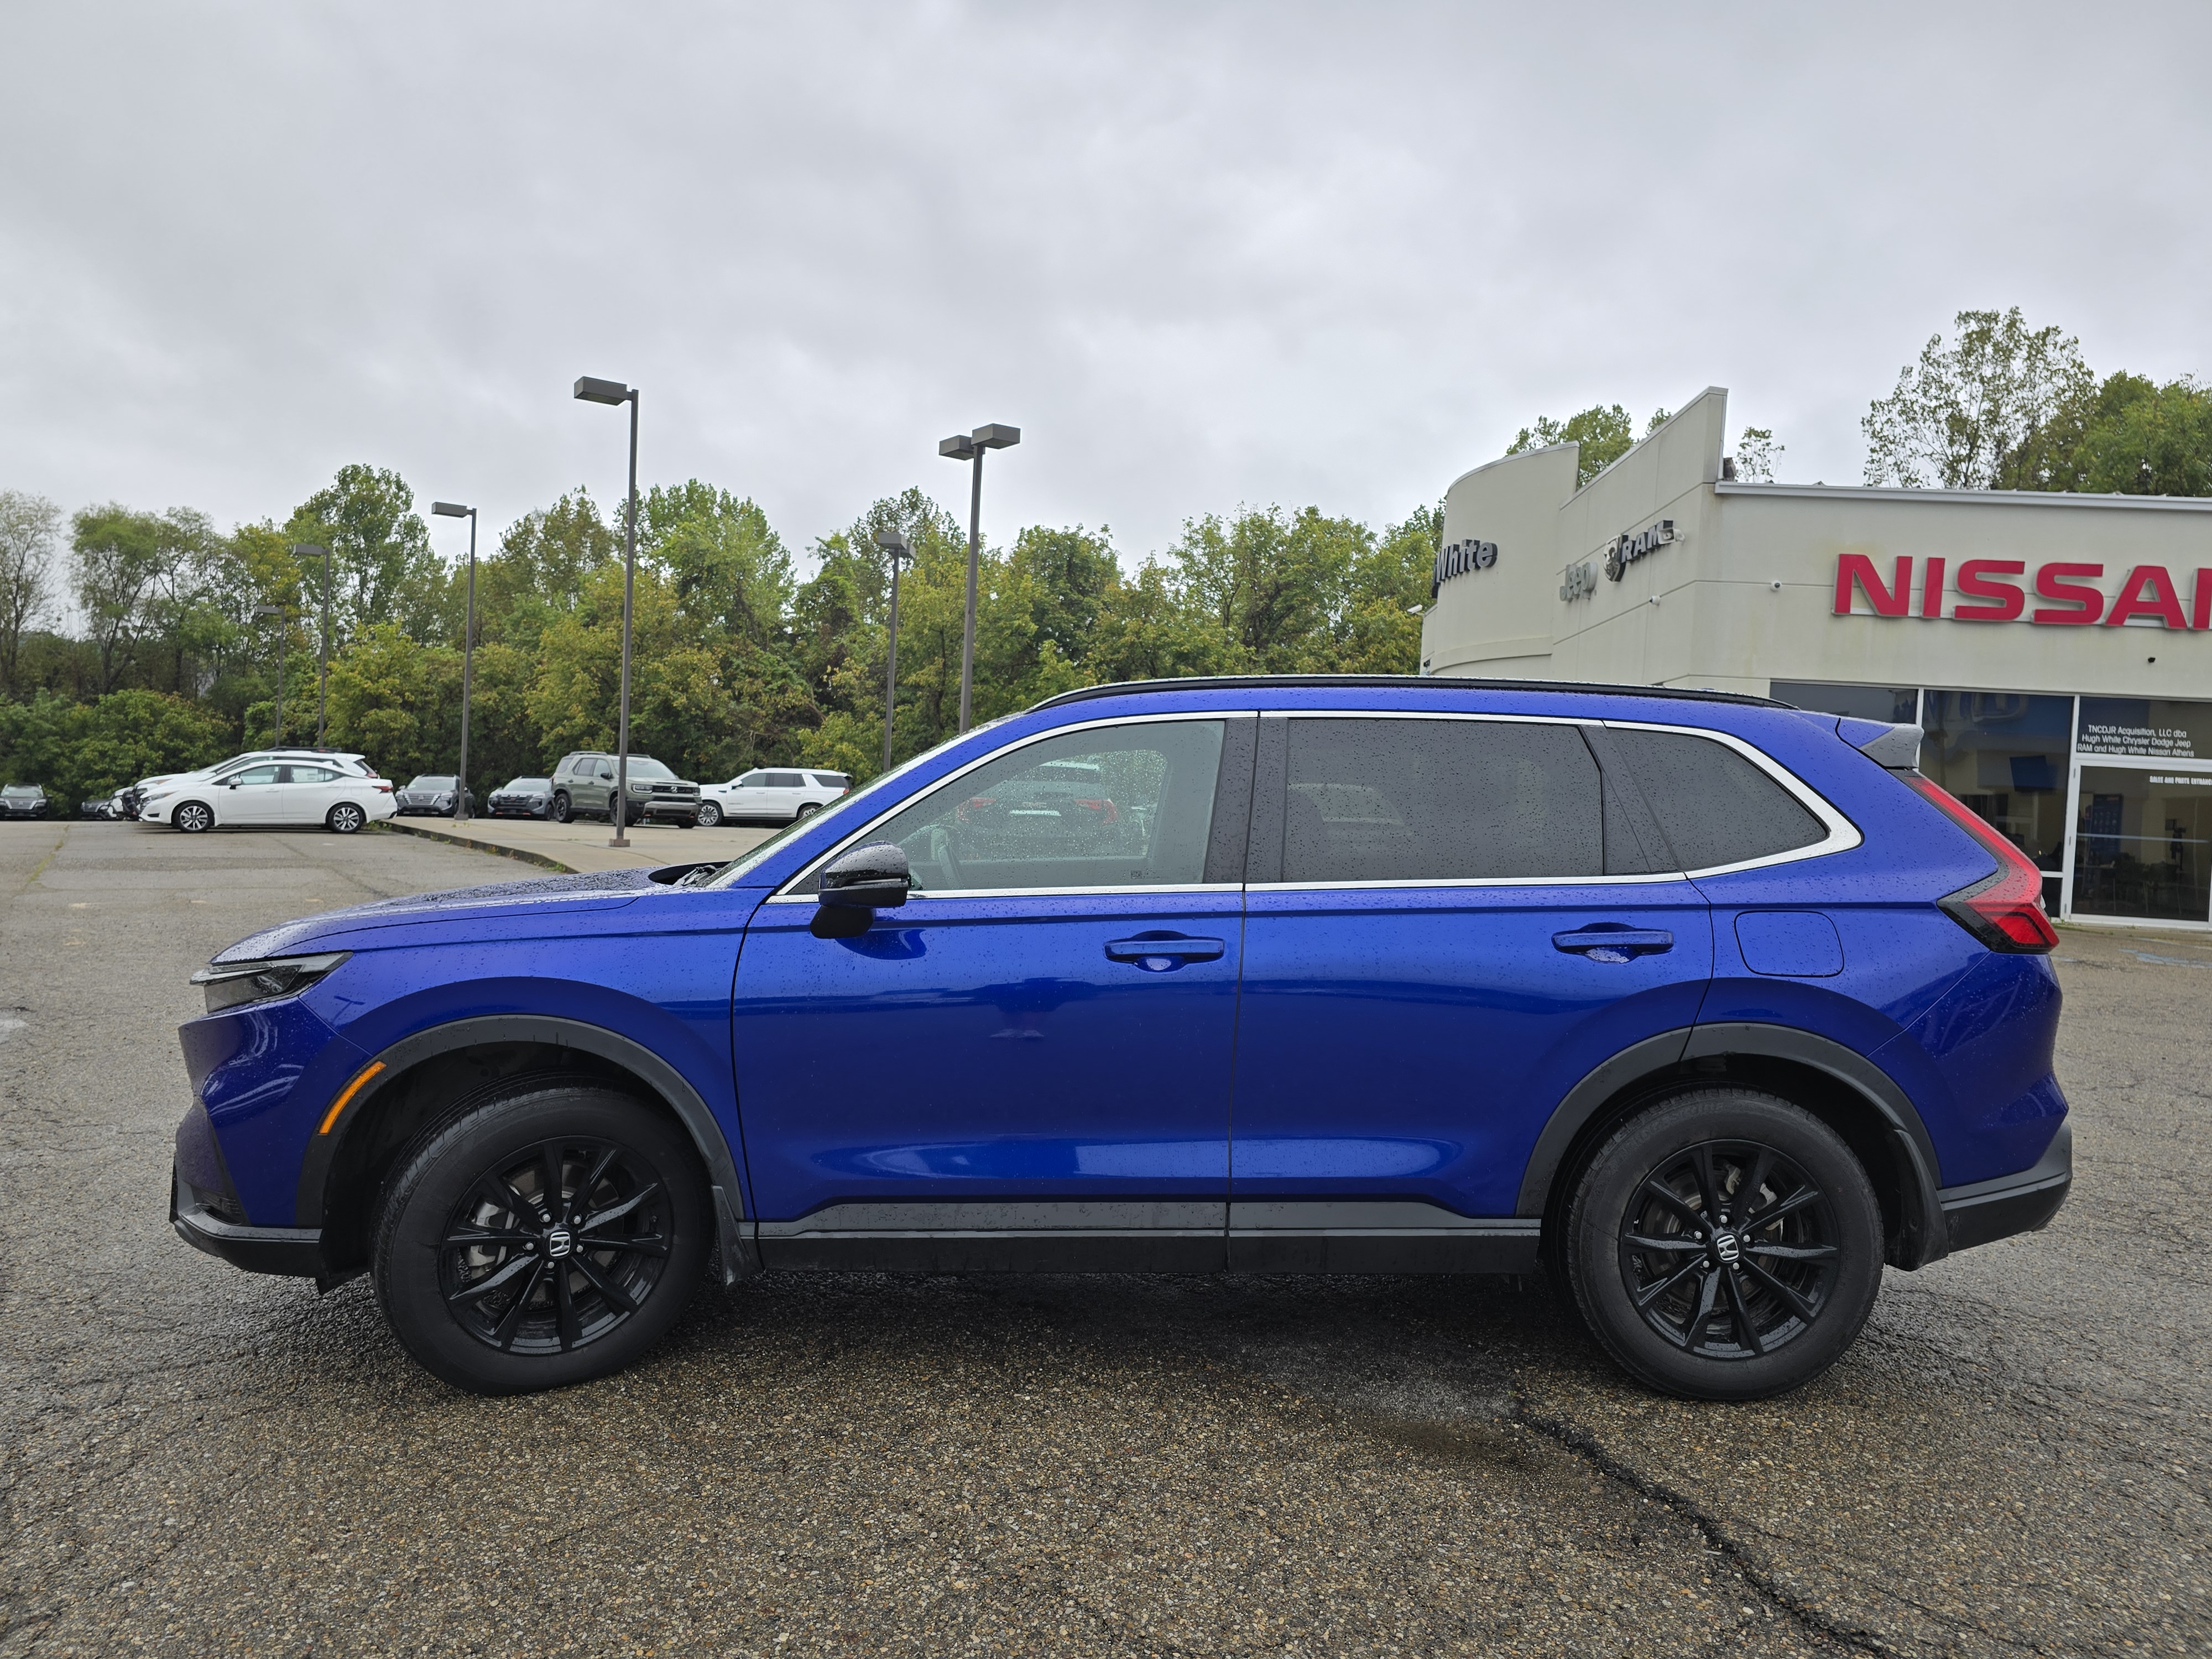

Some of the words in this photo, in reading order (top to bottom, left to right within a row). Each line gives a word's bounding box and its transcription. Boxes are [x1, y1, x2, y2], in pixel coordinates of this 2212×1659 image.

[1436, 539, 1498, 585] White
[1559, 562, 1598, 602] Jeep
[1833, 553, 2212, 631] NISSA
[2088, 724, 2116, 734] TNCDJR
[2159, 728, 2172, 737] LLC
[2173, 729, 2187, 738] dba
[2081, 734, 2100, 744] Hugh
[2102, 734, 2121, 744] White
[2122, 735, 2150, 746] Chrysler
[2151, 737, 2174, 748] Dodge
[2175, 739, 2191, 749] Jeep
[2077, 743, 2093, 752] RAM
[2094, 744, 2107, 753] and
[2108, 744, 2126, 755] Hugh
[2127, 745, 2147, 755] White
[2148, 747, 2171, 757] Nissan
[2191, 778, 2212, 786] ENTRANC
